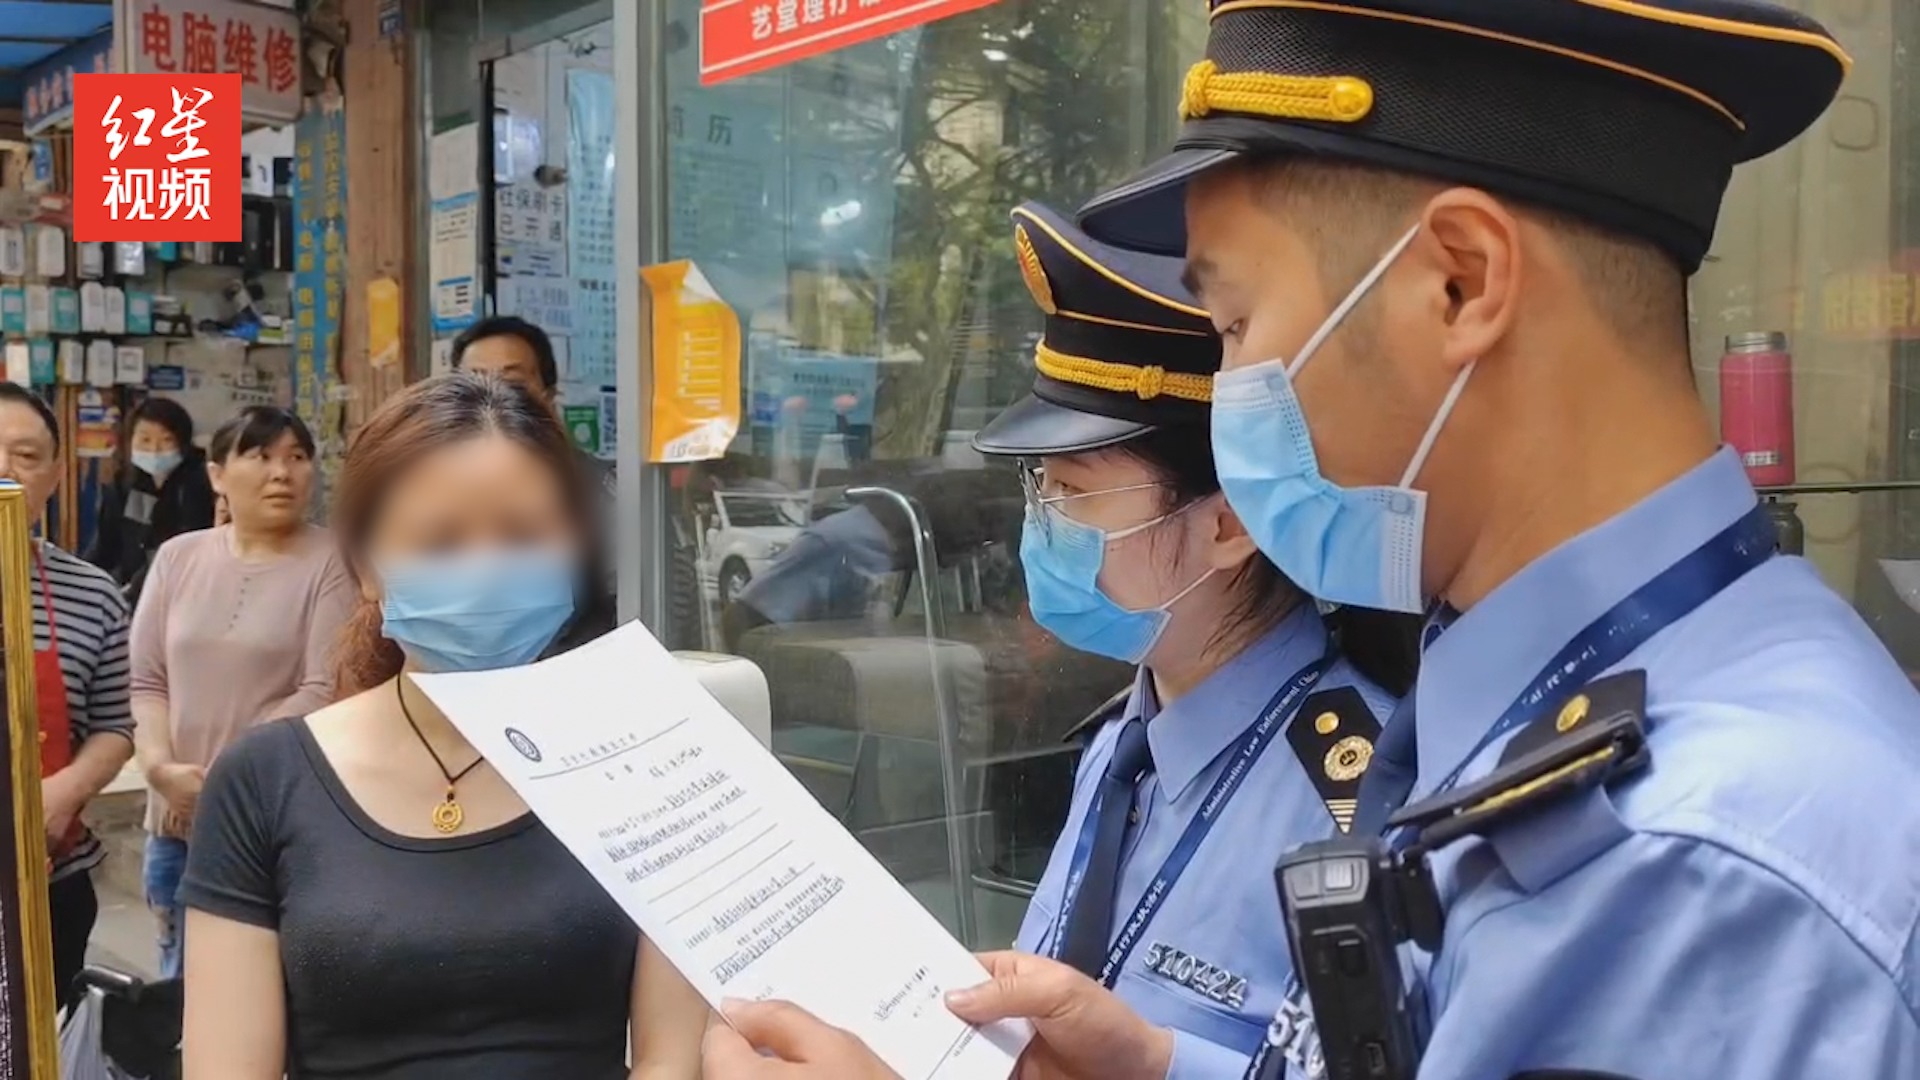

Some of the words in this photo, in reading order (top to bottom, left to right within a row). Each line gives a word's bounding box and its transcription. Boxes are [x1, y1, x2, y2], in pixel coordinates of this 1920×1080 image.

[142, 3, 297, 93] 电脑维修
[1202, 757, 1246, 821] Administrative
[1243, 735, 1260, 758] Law
[1144, 940, 1248, 1010] 510424
